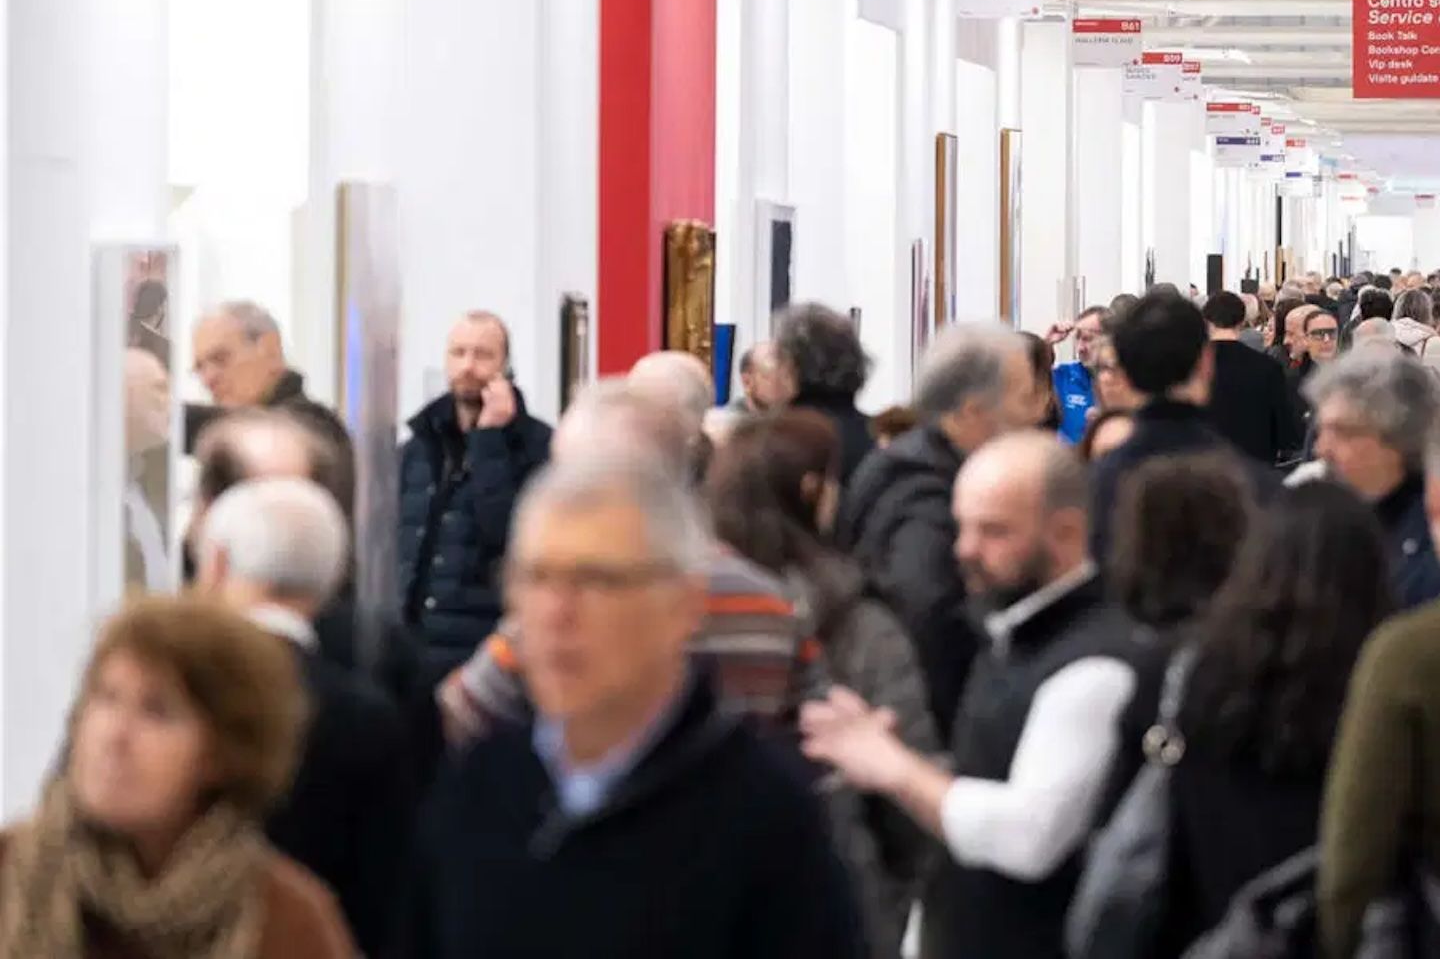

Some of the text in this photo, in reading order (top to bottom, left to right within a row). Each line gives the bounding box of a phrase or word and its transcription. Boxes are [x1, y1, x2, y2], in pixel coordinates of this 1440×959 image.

[1367, 9, 1433, 25] Service
[1367, 30, 1418, 41] Book Talk
[1367, 44, 1418, 56] Bookshop
[1367, 59, 1413, 71] Vip desk
[1367, 73, 1398, 83] Visite
[1400, 73, 1439, 85] guidate
